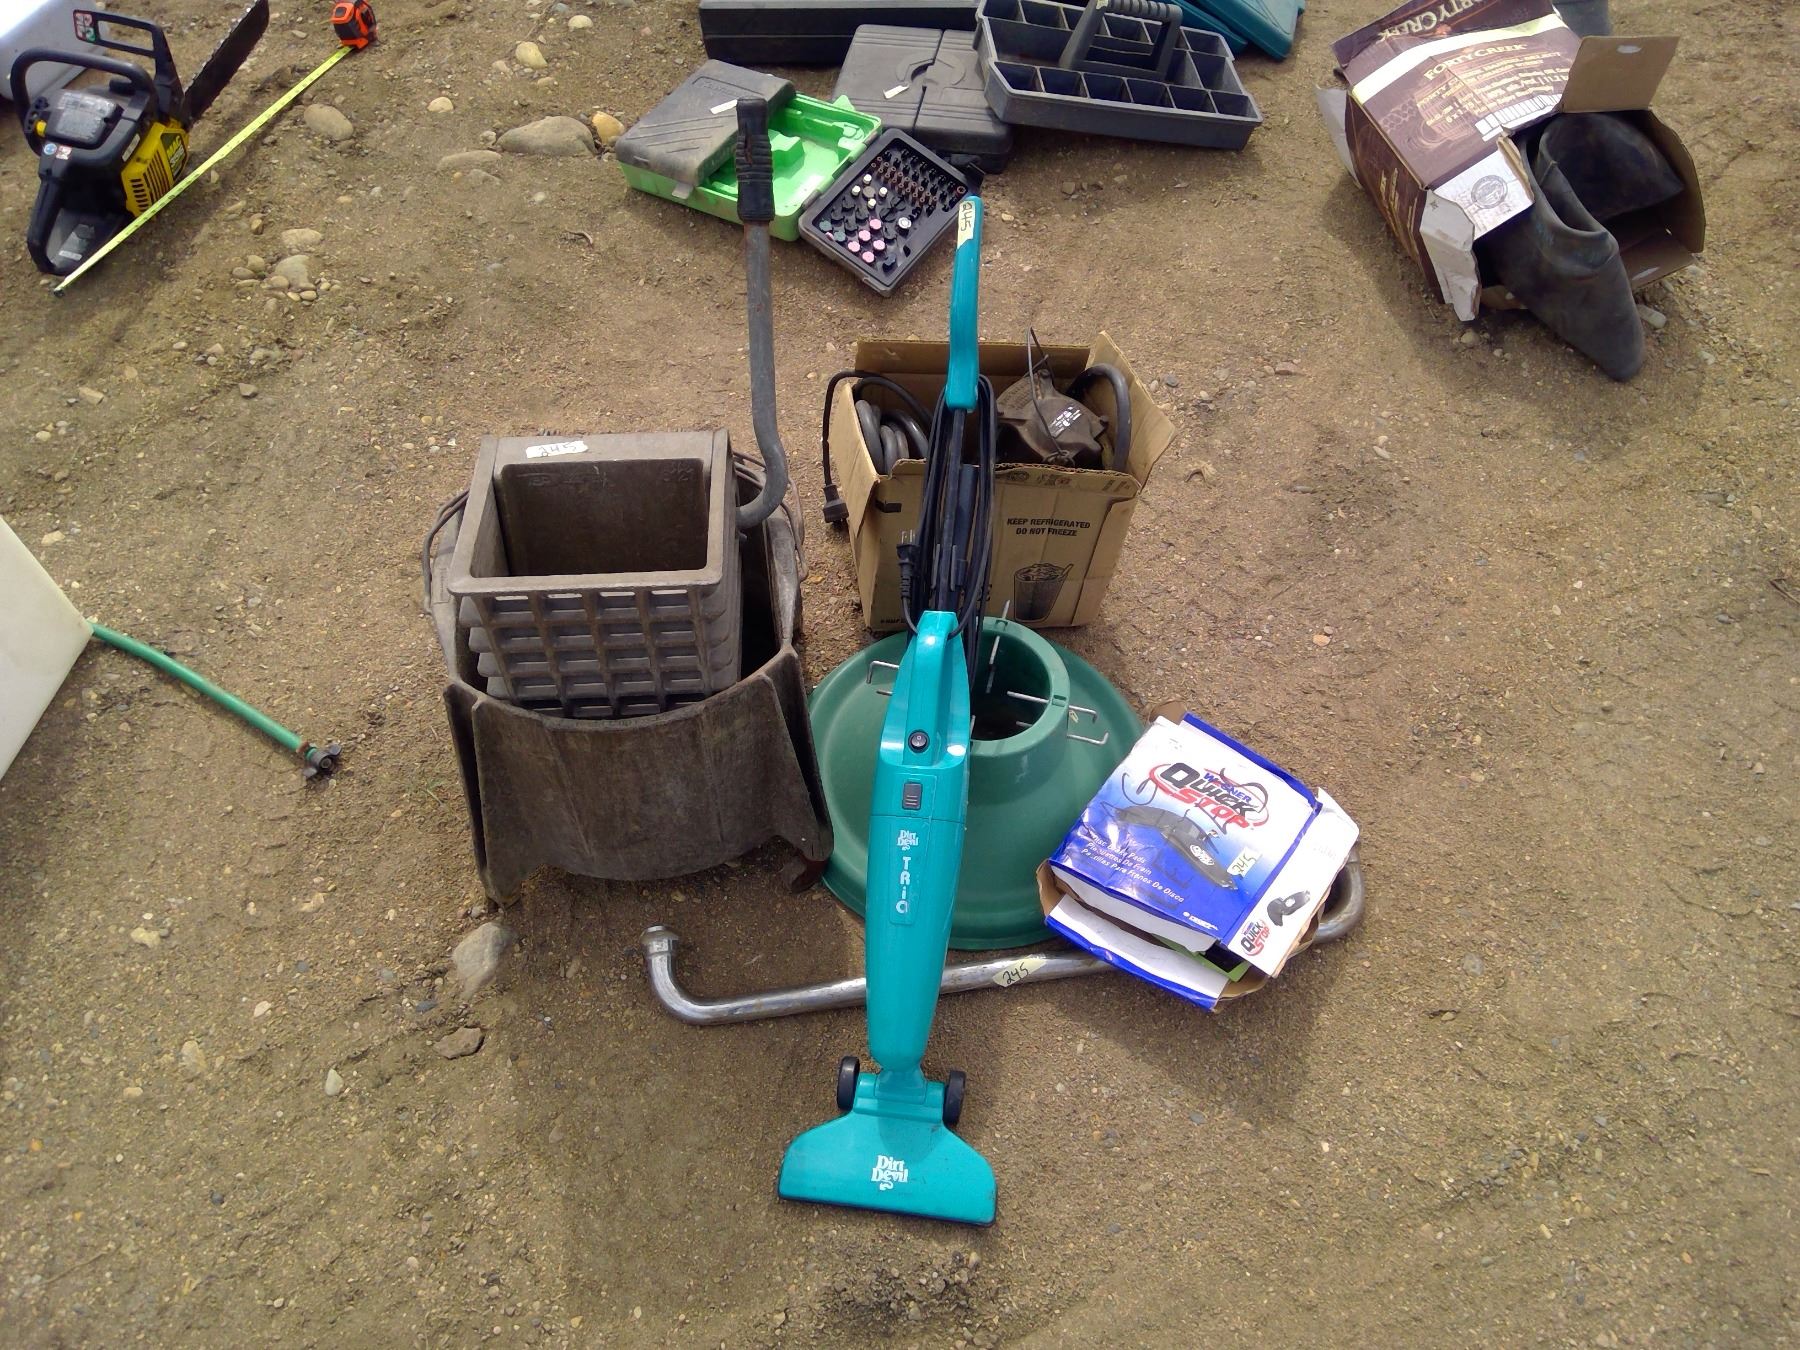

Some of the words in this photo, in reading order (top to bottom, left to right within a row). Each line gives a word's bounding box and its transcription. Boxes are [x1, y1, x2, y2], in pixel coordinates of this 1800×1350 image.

[1376, 11, 1437, 42] CREEK
[1424, 54, 1474, 81] FORTY
[1474, 43, 1528, 58] CREEK
[960, 201, 973, 232] 245
[539, 442, 577, 458] 245
[1007, 518, 1028, 526] KEEP
[1030, 518, 1091, 529] REFRIGERATED
[1016, 527, 1028, 535] DO
[1029, 527, 1047, 535] NOT
[1047, 527, 1078, 537] FREEZE
[1160, 762, 1258, 817] QUICK
[1169, 788, 1250, 828] STOP
[1128, 852, 1146, 864] Pads
[1231, 852, 1257, 874] 245
[1002, 961, 1029, 985] 245
[876, 1154, 905, 1172] Dirt
[870, 1168, 909, 1183] Devil
